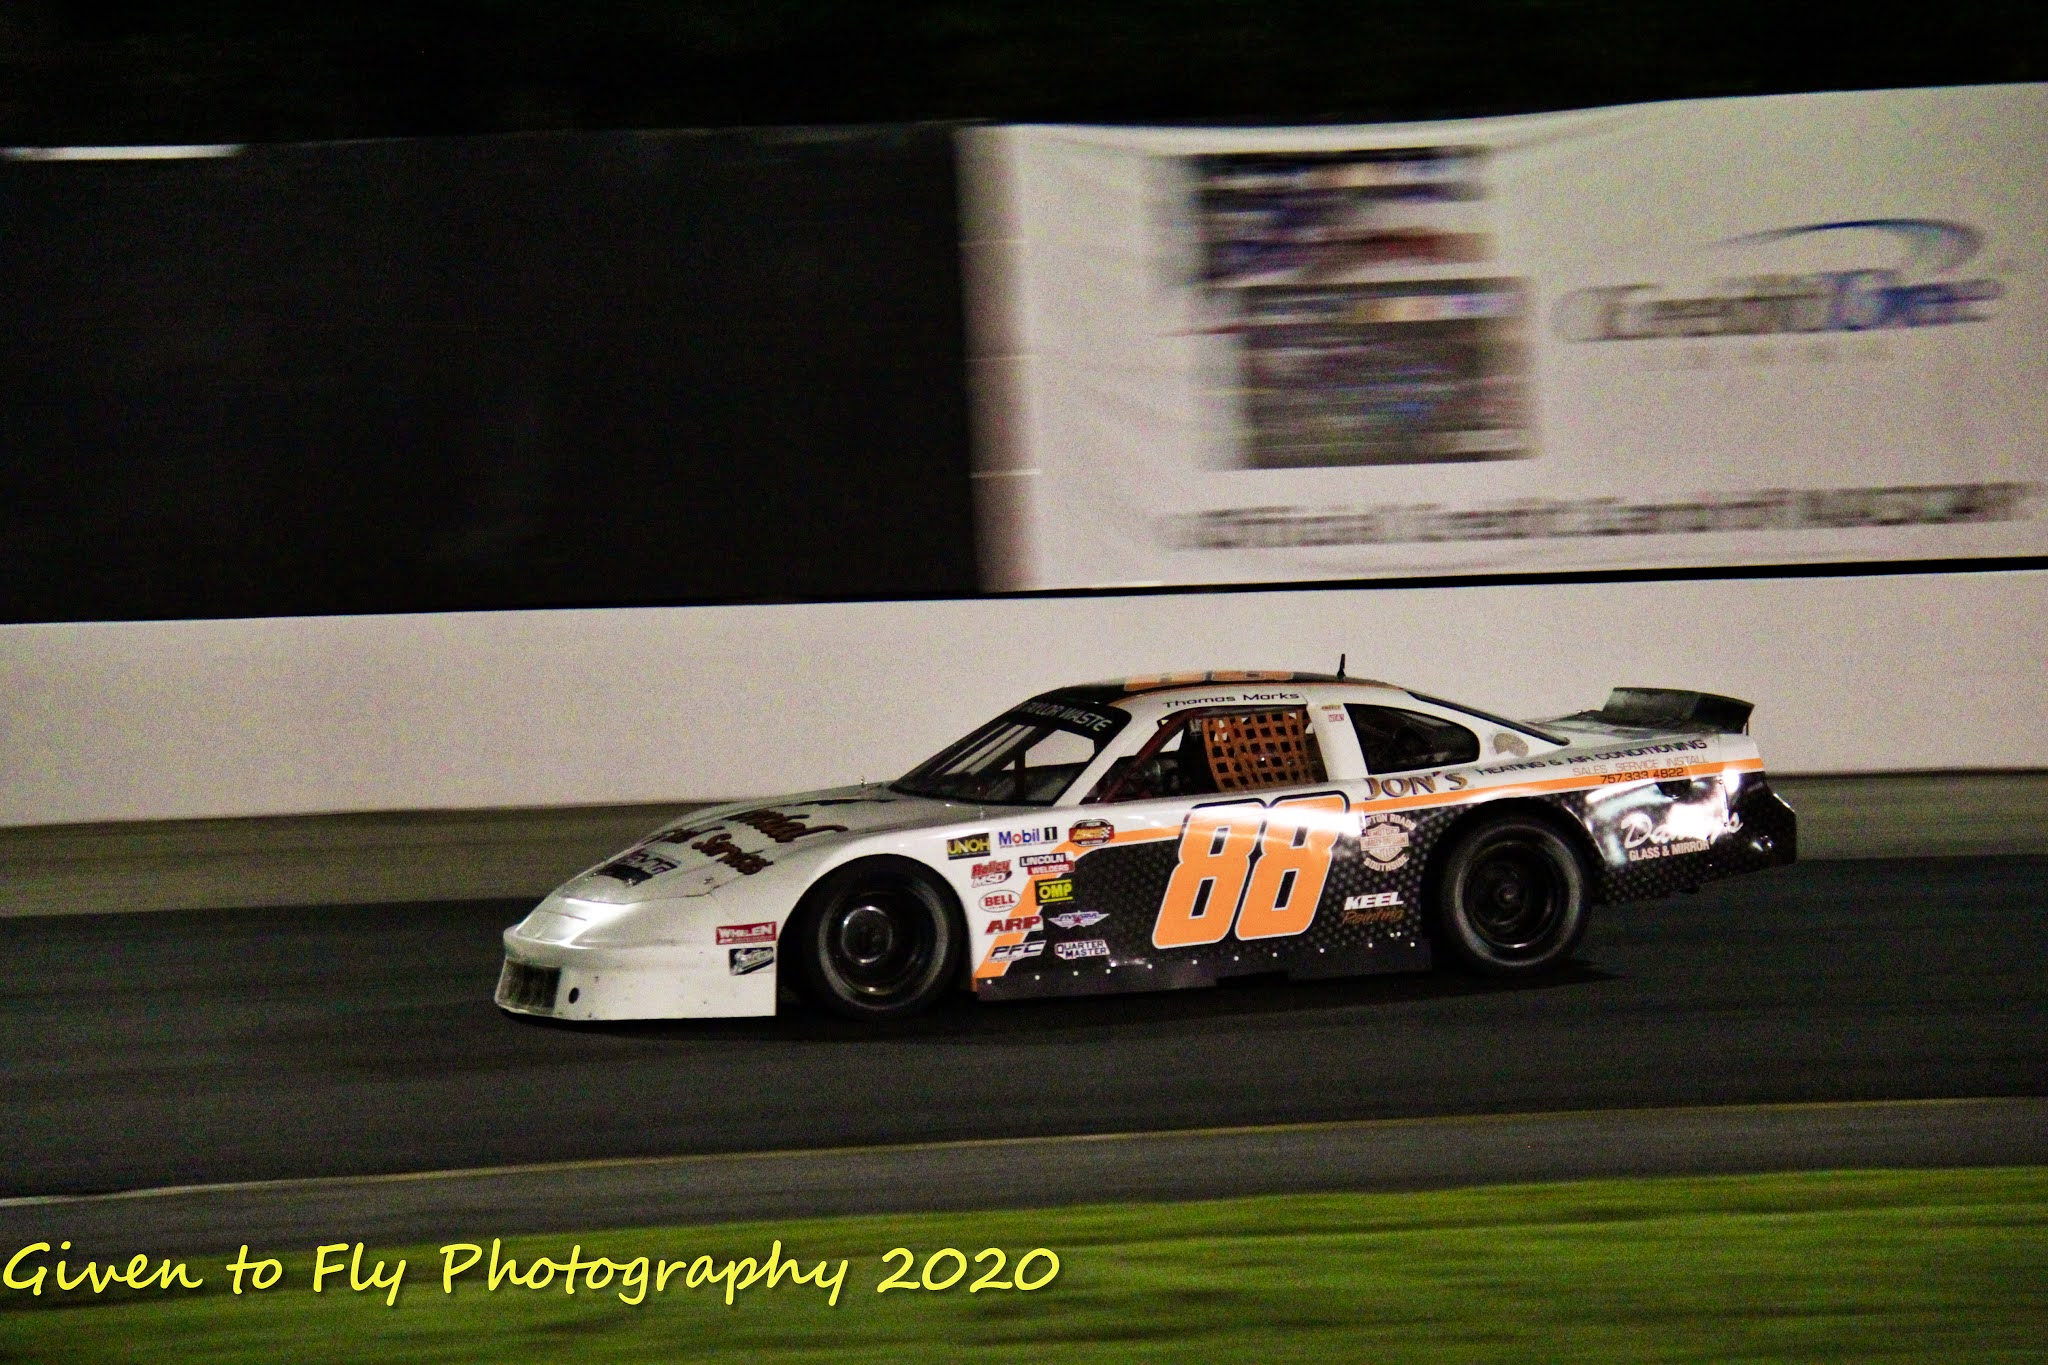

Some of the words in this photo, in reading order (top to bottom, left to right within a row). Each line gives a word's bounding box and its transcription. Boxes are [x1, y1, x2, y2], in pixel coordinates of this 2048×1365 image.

[1163, 696, 1236, 709] Thomas
[1242, 692, 1300, 701] Marks
[1059, 706, 1113, 732] WASTE
[1475, 760, 1546, 776] HEATING
[1567, 755, 1594, 766] AIR
[1595, 739, 1708, 761] CONDITIONING
[1572, 764, 1607, 777] SALES
[1616, 759, 1658, 773] SERVICE
[1666, 755, 1708, 768] INSTALL
[1364, 771, 1468, 801] JON'S
[1389, 813, 1417, 831] ROADS
[948, 837, 990, 855] UNOH
[998, 828, 1040, 846] Mobil
[1021, 854, 1064, 866] LINCOLN
[1629, 846, 1660, 862] GLASS
[1662, 845, 1670, 857] &
[1671, 840, 1710, 856] MIRROR
[1152, 791, 1349, 950] 88
[1363, 853, 1410, 872] SOUTHSIDE
[1039, 882, 1073, 899] OMP
[984, 893, 1015, 907] BELL
[1344, 891, 1405, 911] KEEL
[719, 924, 773, 939] WHELEN
[985, 915, 1042, 935] ARP
[991, 941, 1047, 958] PFC
[1055, 940, 1104, 954] QUARTER
[1066, 947, 1107, 958] MASTER
